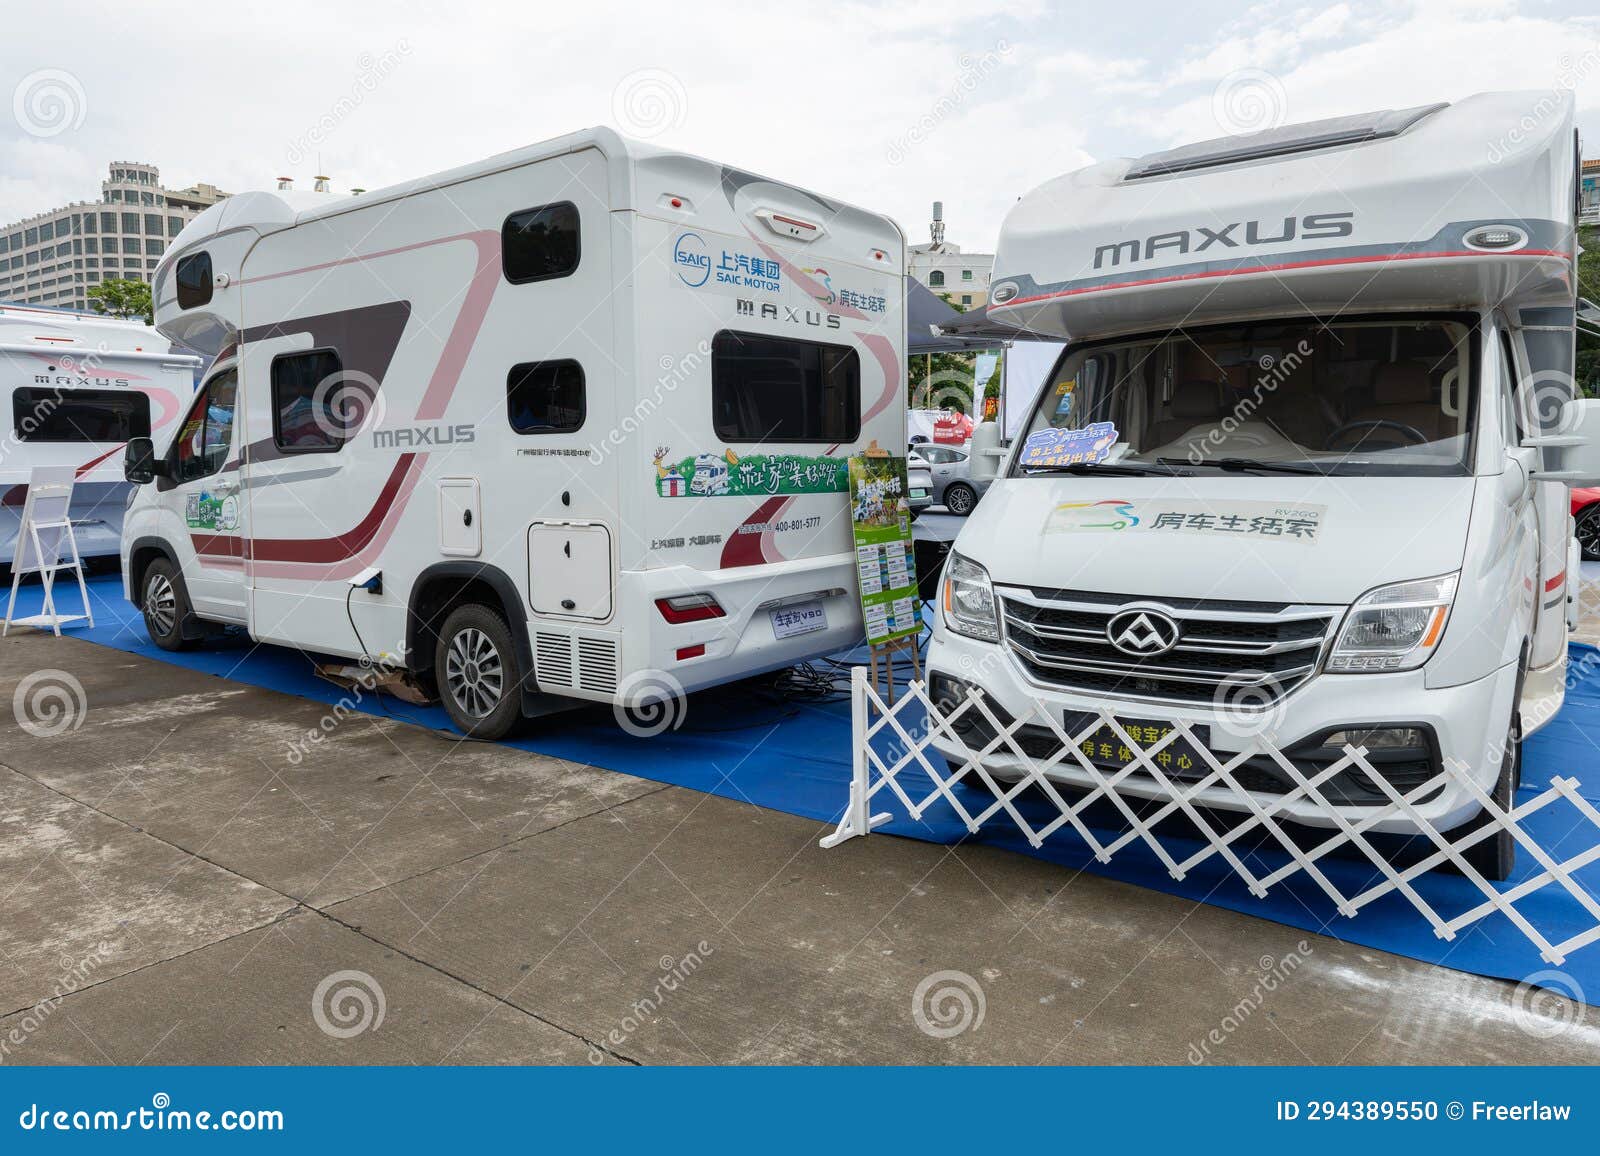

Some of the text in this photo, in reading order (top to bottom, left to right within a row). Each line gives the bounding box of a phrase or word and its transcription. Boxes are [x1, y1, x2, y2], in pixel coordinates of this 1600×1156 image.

[1092, 212, 1355, 269] MAXUS
[677, 251, 708, 267] SAIC
[716, 250, 780, 280] 上汽集团
[716, 272, 780, 292] SAIC MOTOR
[736, 298, 841, 329] MAXUS
[34, 375, 129, 387] MAXUS
[373, 424, 476, 448] MAXUS
[1149, 512, 1319, 538] 房车生活家
[1081, 740, 1193, 769] 房车体中心
